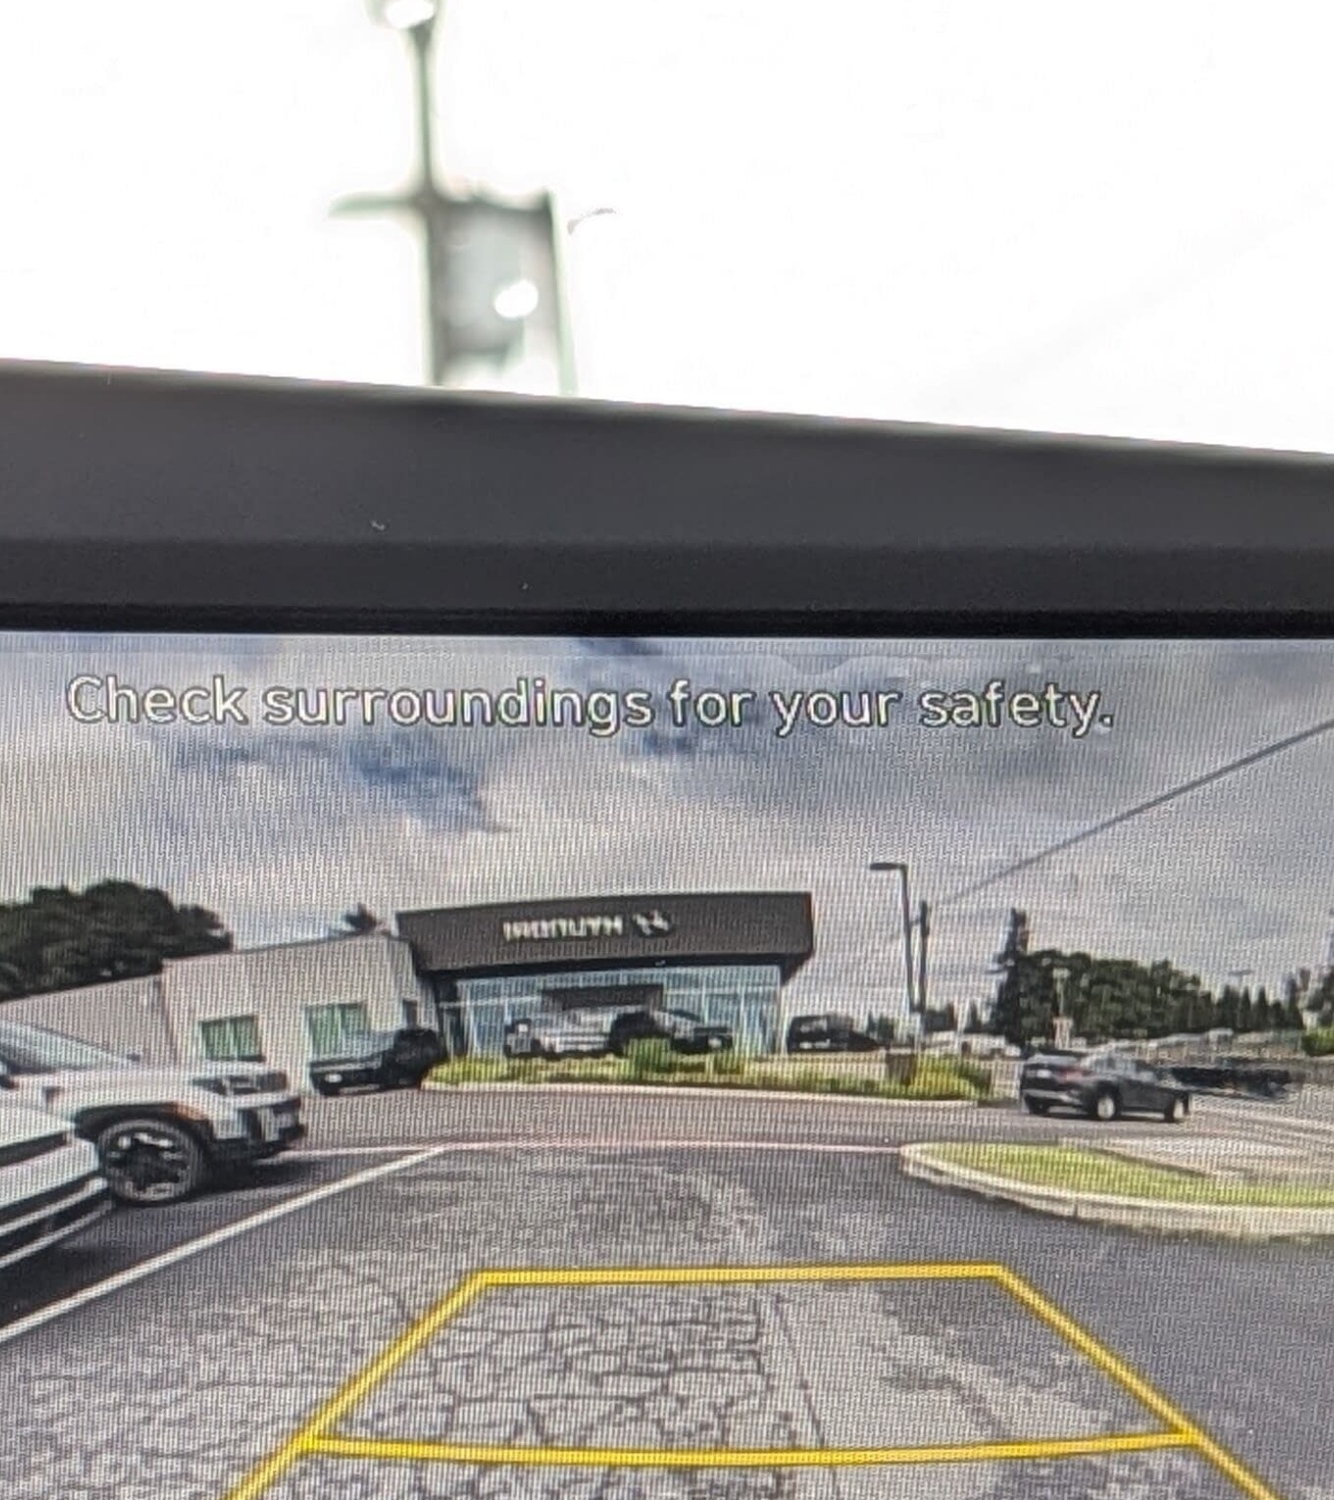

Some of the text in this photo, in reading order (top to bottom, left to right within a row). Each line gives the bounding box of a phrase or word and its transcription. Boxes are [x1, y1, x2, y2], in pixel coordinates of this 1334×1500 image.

[66, 674, 1115, 737] Check surroundings for your safety.
